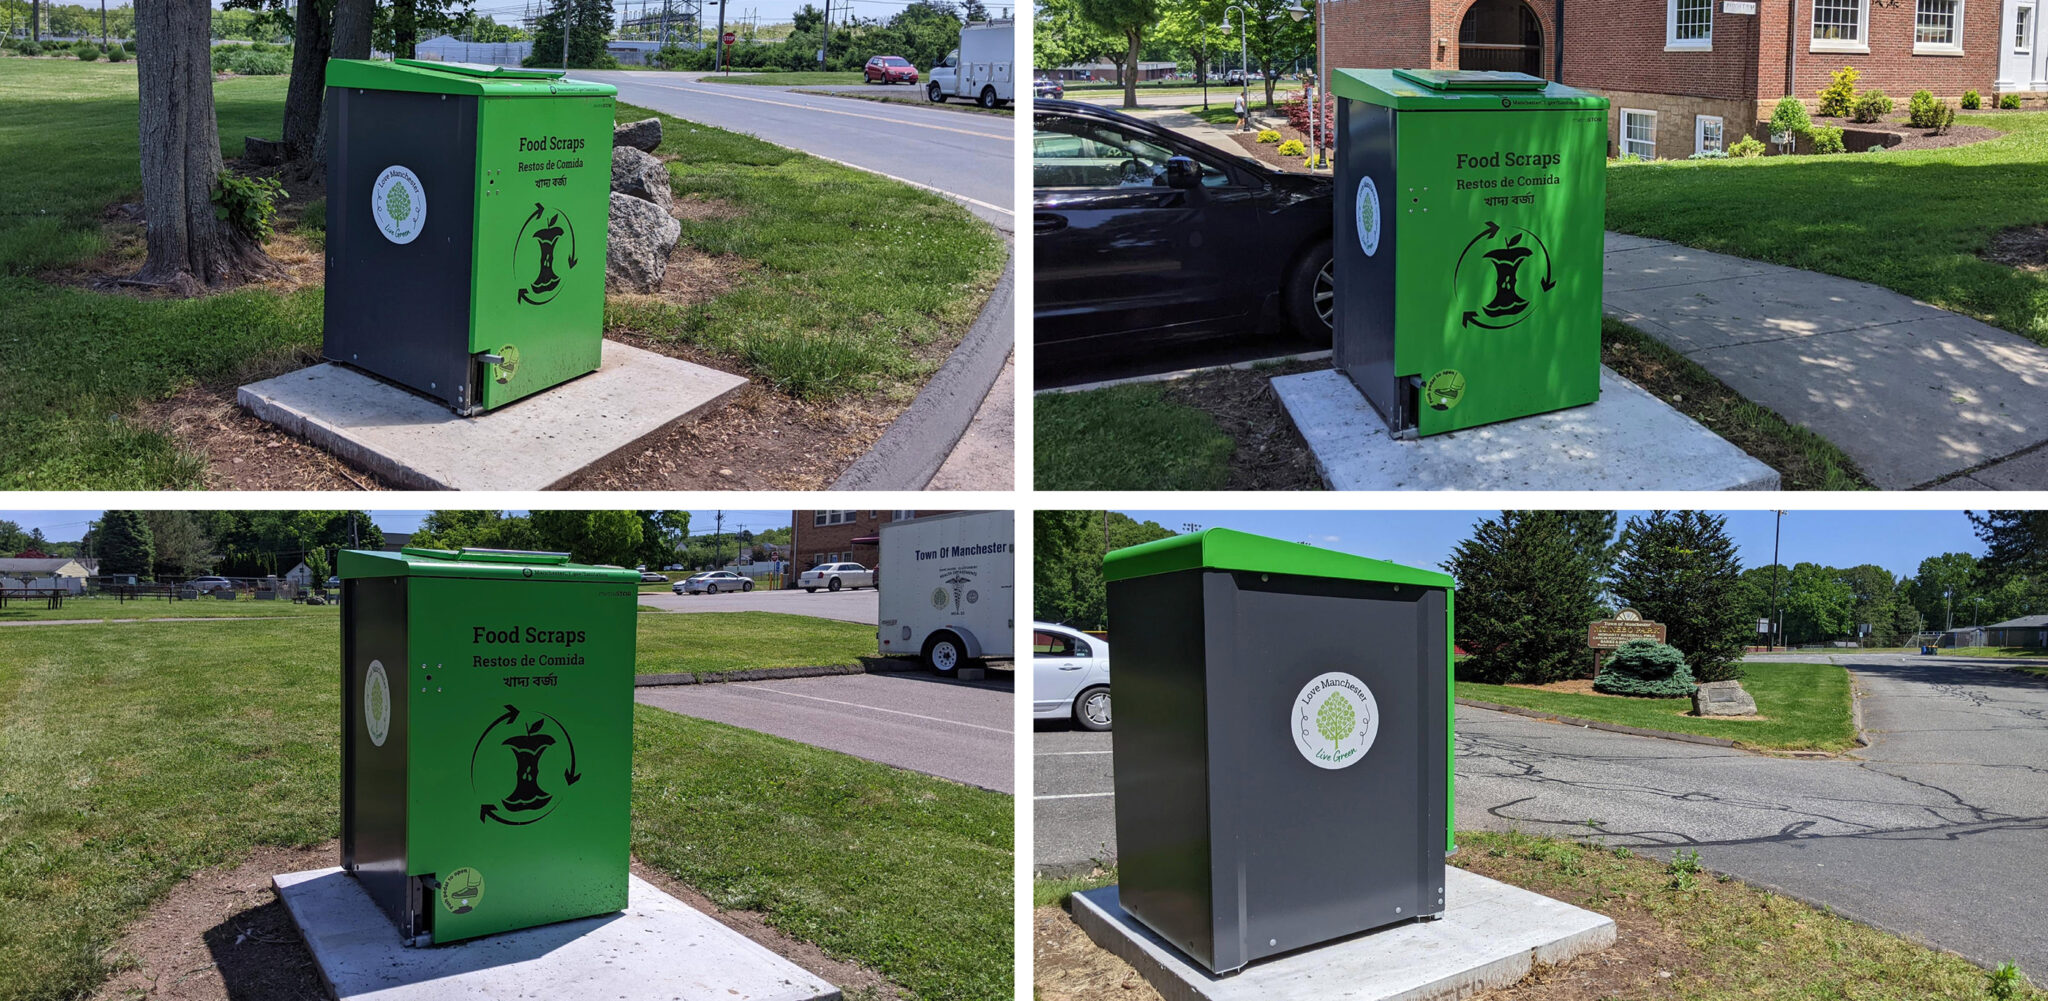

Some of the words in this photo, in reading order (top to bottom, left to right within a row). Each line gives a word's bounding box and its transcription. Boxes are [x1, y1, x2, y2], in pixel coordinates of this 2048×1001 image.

[519, 136, 547, 152] Food
[549, 136, 585, 153] Scraps
[518, 161, 544, 172] Restos
[546, 160, 555, 170] de
[556, 158, 584, 169] Comida
[1456, 152, 1500, 169] Food
[1505, 152, 1560, 169] Scraps
[378, 174, 390, 188] Love
[390, 170, 419, 193] Manchester
[1456, 179, 1497, 190] Restos
[1500, 177, 1514, 188] de
[1517, 174, 1560, 186] Comida
[385, 224, 394, 235] Live
[395, 228, 411, 239] Green
[915, 550, 937, 561] Town
[940, 547, 949, 559] Of
[951, 542, 1007, 557] Manchester
[473, 626, 520, 644] Food
[525, 626, 586, 647] Scraps
[473, 655, 517, 667] Restos
[520, 654, 536, 666] de
[539, 653, 585, 666] Comida
[1302, 685, 1320, 705] Love
[1320, 679, 1367, 702] Manchester
[1315, 747, 1331, 761] Live
[1333, 747, 1357, 762] Green
